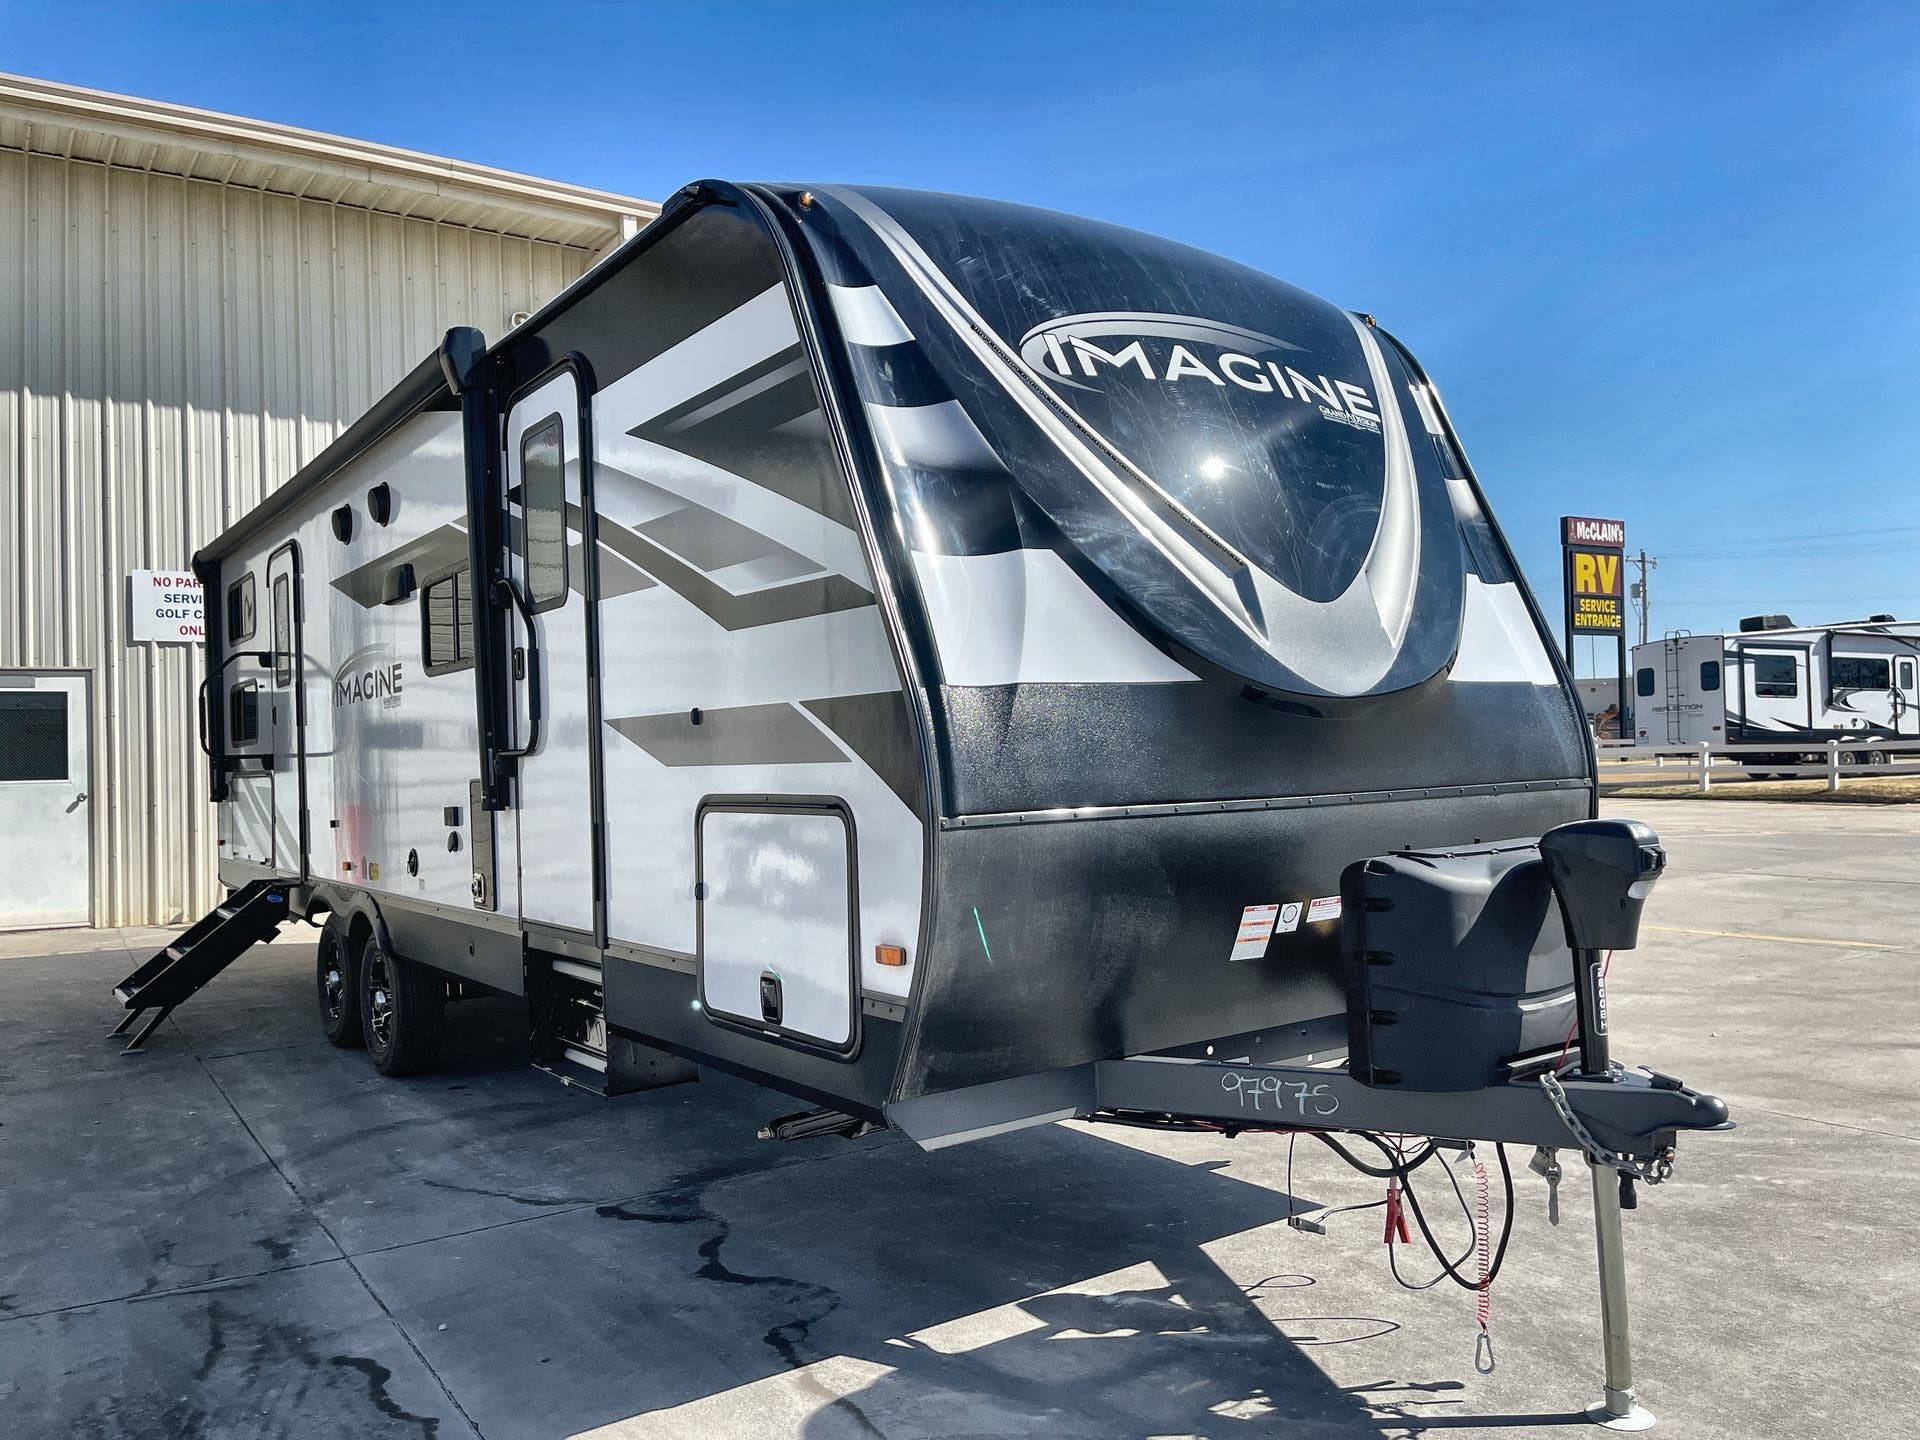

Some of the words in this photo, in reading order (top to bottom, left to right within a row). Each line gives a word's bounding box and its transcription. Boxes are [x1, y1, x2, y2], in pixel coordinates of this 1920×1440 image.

[1042, 332, 1381, 423] IMAGINE
[153, 577, 171, 587] NO
[176, 577, 204, 588] PAR
[1575, 553, 1618, 594] RV
[155, 608, 190, 619] GOLF
[194, 609, 205, 620] C
[1580, 599, 1616, 613] SERVICE
[1574, 613, 1622, 628] ENTRANCE
[335, 662, 403, 708] IMAGINE
[1221, 1072, 1339, 1115] 97975
